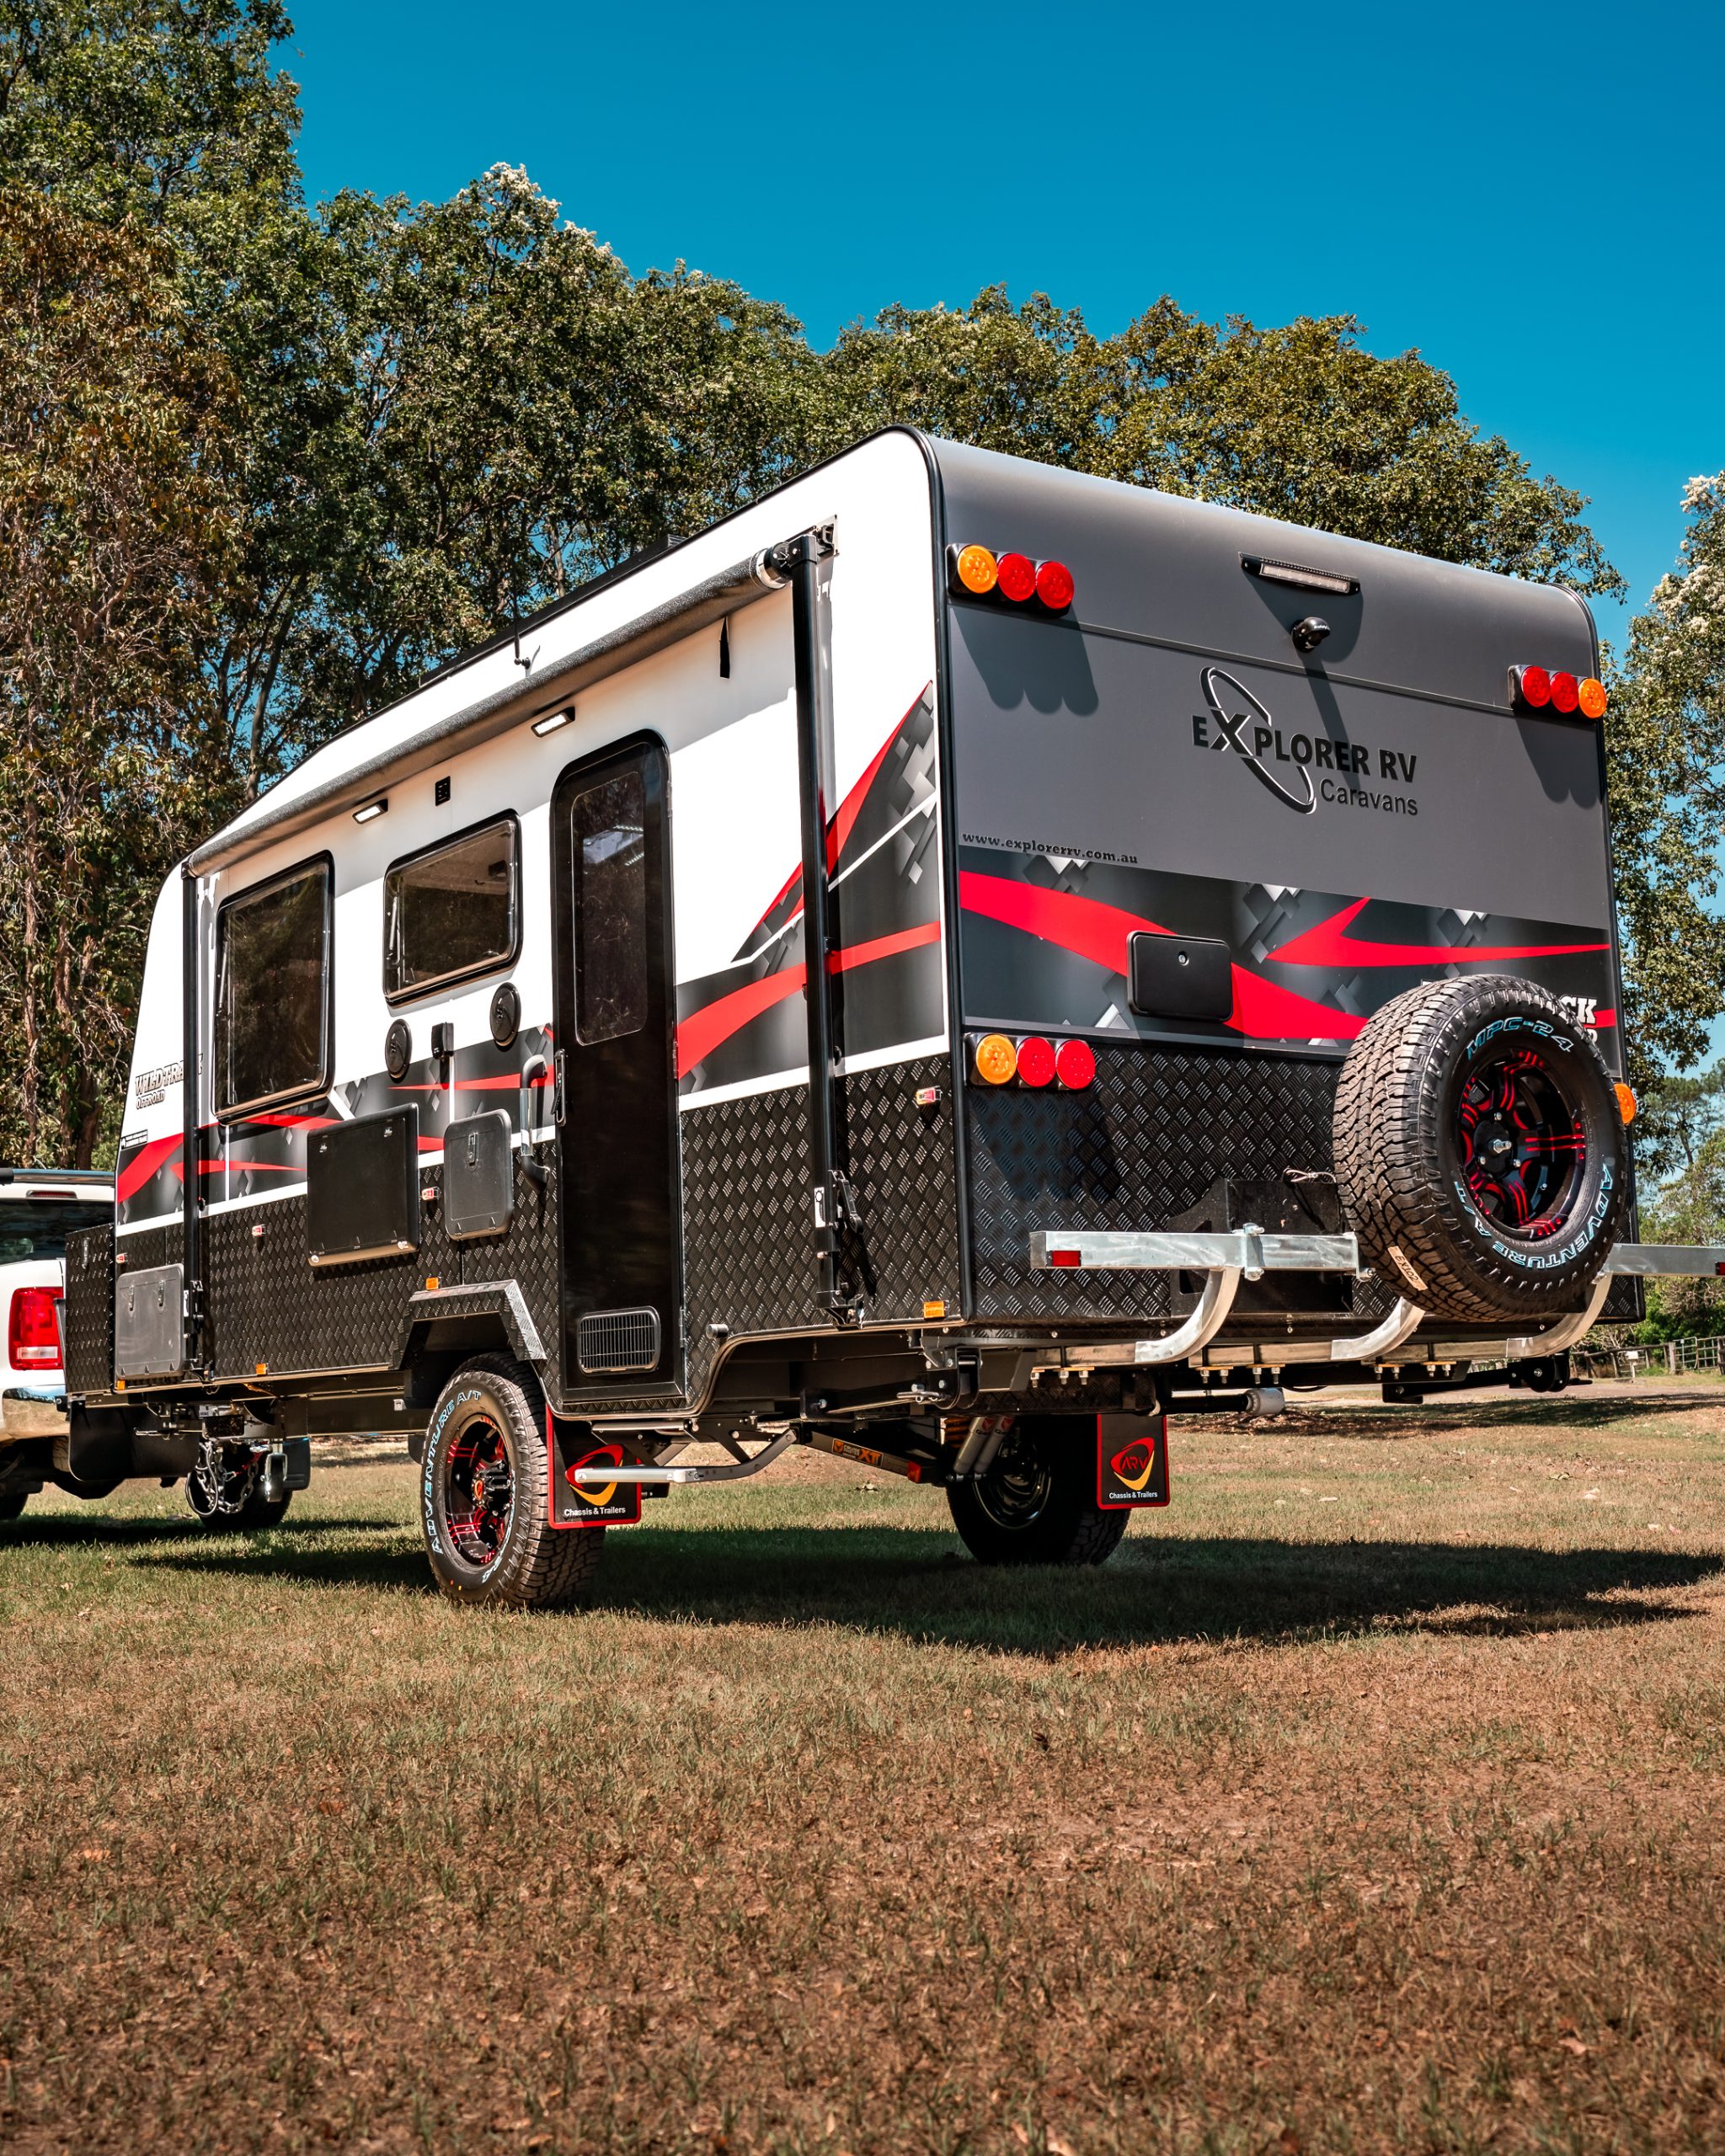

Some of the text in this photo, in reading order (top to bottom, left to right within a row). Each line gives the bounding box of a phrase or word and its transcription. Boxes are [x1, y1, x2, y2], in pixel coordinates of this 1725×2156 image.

[1192, 708, 1418, 783] EXPLORER RV
[1319, 777, 1419, 816] Caravans
[962, 833, 1139, 865] www.explorerrv.com.au
[1453, 1162, 1614, 1270] ADVENTURE A/T
[1395, 1255, 1419, 1282] EX102
[424, 1389, 482, 1556] ADVENTURE A/T
[563, 1508, 592, 1517] Chassis
[599, 1506, 626, 1515] Trailers
